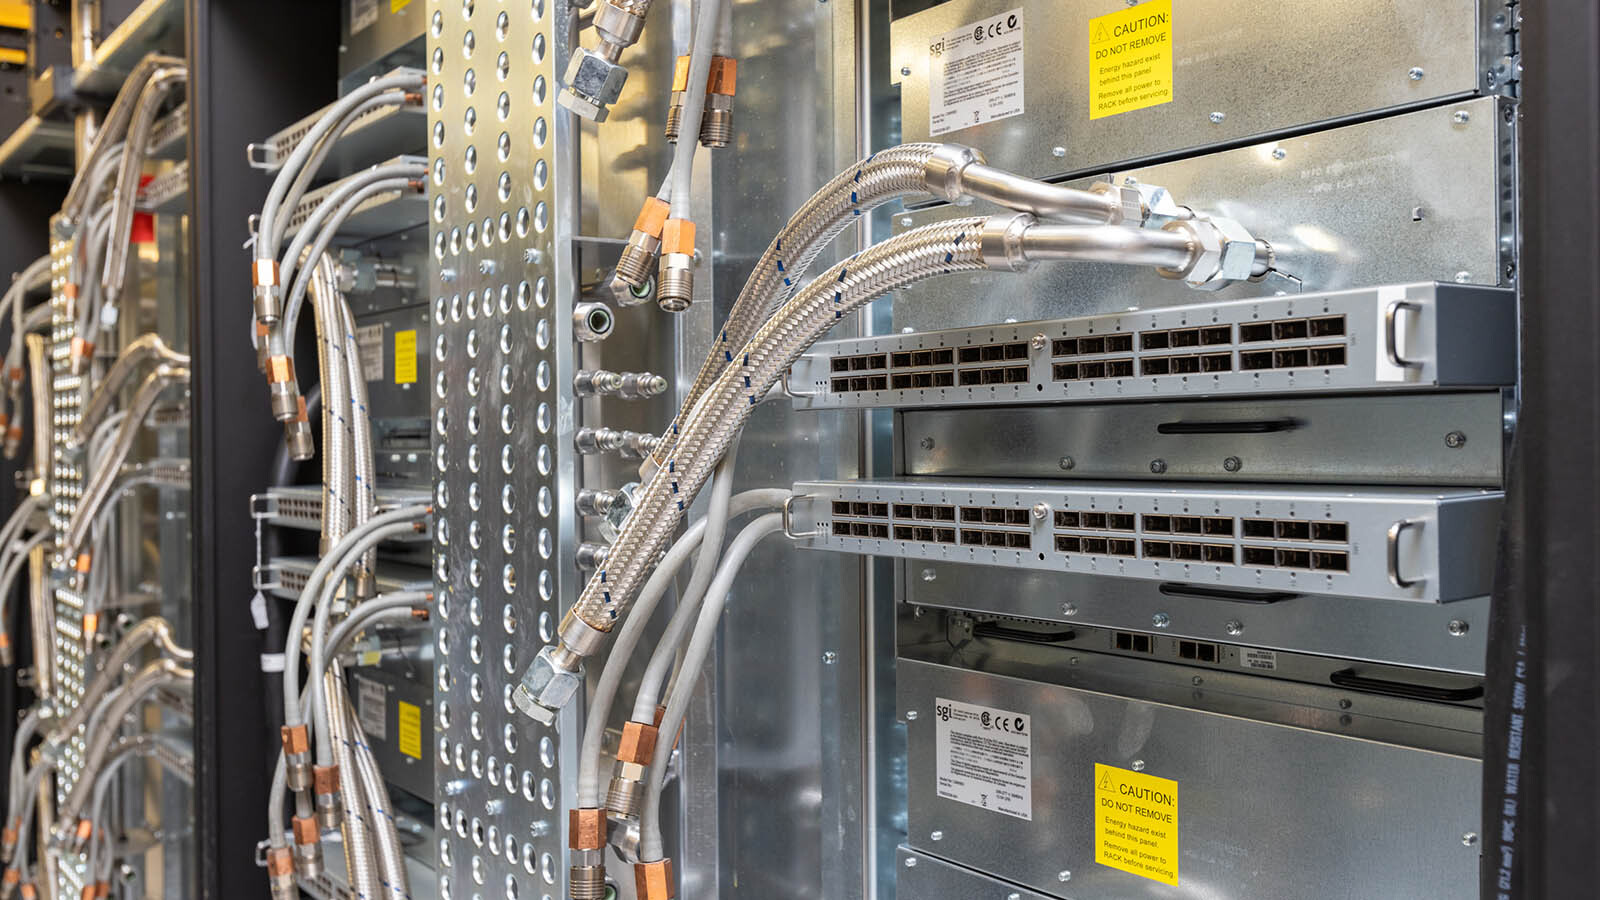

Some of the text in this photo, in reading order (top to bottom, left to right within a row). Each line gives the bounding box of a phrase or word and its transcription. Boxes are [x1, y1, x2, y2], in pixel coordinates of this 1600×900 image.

[1113, 12, 1169, 38] CAUTION:
[929, 37, 945, 57] sgi
[1095, 32, 1166, 60] DO NOT REMOVE
[1099, 53, 1161, 75] Energy hazard exist
[1121, 71, 1132, 80] this
[1098, 89, 1123, 100] Remove
[1133, 81, 1153, 91] power
[1098, 100, 1117, 110] RACK
[1118, 94, 1139, 106] before
[936, 703, 952, 722] sgi
[1507, 713, 1525, 759] RESISTANT
[1505, 763, 1520, 795] WATER
[1119, 783, 1175, 807] CAUTION:
[1101, 797, 1173, 824] DO NOT REMOVE
[1105, 816, 1167, 839] Energy hazard exist
[1105, 827, 1126, 839] behind
[1127, 833, 1138, 842] this
[1104, 840, 1167, 865] Remove all power to
[1104, 850, 1122, 862] RACK
[1124, 857, 1144, 869] before
